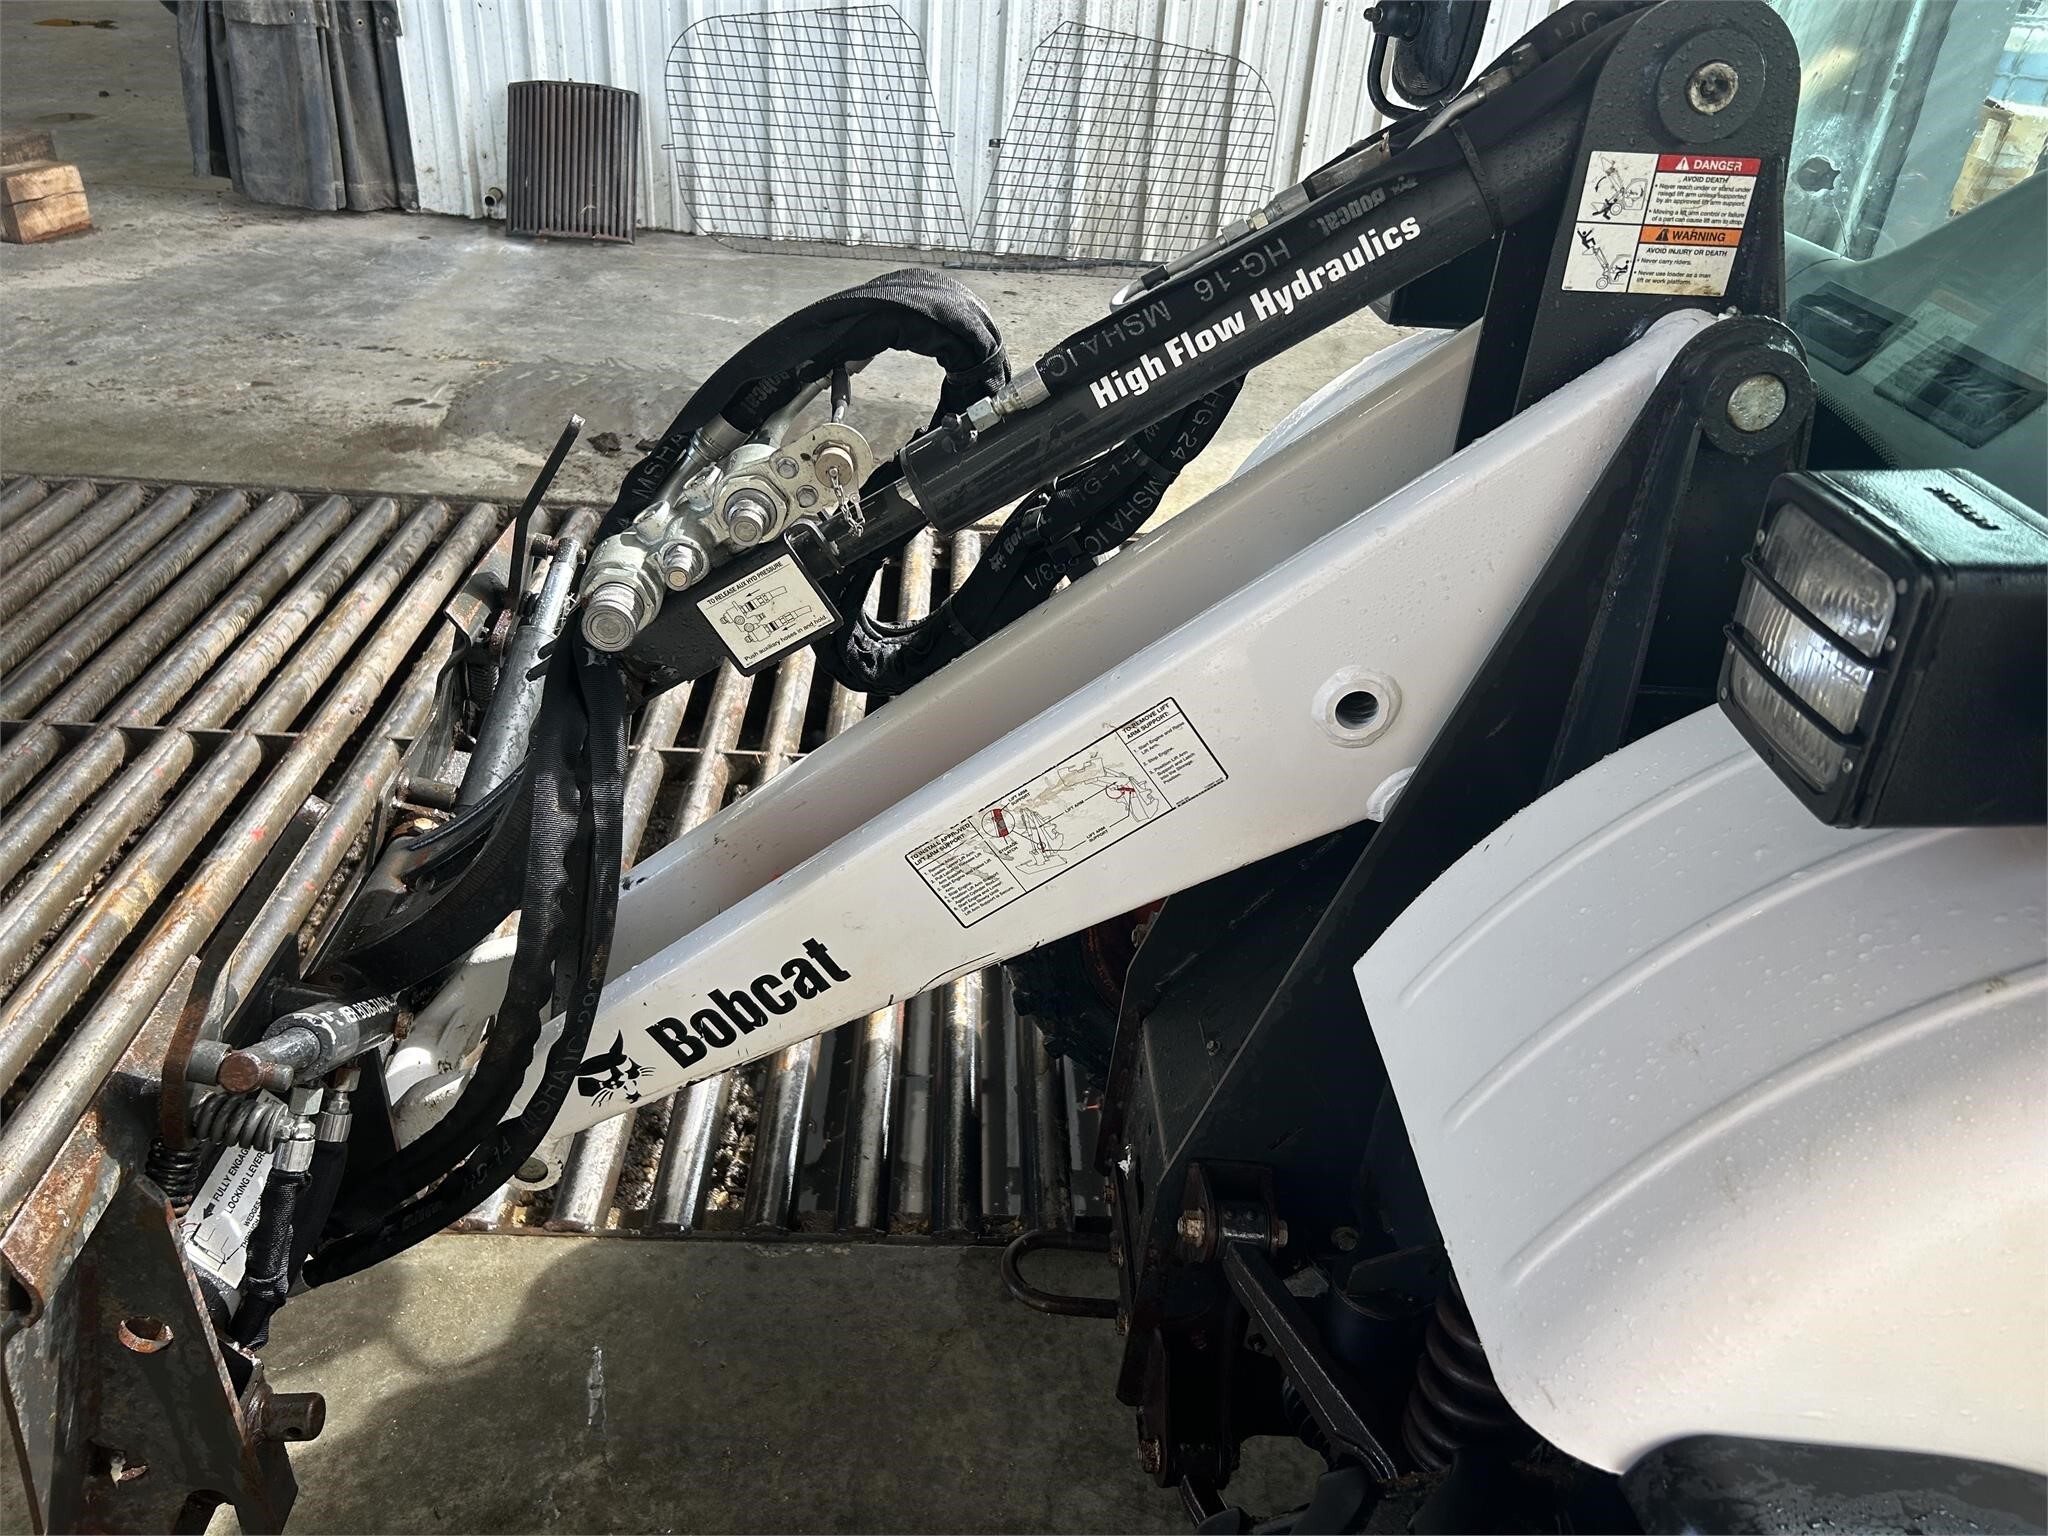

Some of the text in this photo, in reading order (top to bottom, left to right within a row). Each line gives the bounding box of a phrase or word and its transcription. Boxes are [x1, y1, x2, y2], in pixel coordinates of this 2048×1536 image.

[1694, 160, 1742, 171] DANGER
[1668, 248, 1692, 256] INJURY
[1673, 231, 1725, 242] WARNING
[1194, 237, 1292, 302] HG-16
[1089, 216, 1421, 409] High Flow Hydraulics
[1083, 300, 1172, 359] MSHA
[1106, 480, 1163, 533] MSHA
[707, 561, 782, 605] TO RELEASE AUX HYD PRESSURE
[744, 650, 758, 661] Push
[758, 639, 781, 654] auxiliary
[780, 630, 797, 642] hoses
[802, 621, 814, 630] and
[1122, 702, 1170, 733] TO REMOVE LIFT
[1126, 728, 1140, 738] ARM
[1138, 741, 1149, 749] Start
[1148, 733, 1164, 744] Engine
[1147, 755, 1159, 764] Stop
[1173, 758, 1183, 766] and
[1064, 799, 1084, 813] LIFT ARM
[917, 840, 941, 855] INSTALL
[940, 823, 970, 842] APPROVED
[914, 856, 927, 865] LIFT
[926, 848, 939, 858] ARM
[645, 938, 852, 1069] Bobcat
[213, 1148, 249, 1201] FULLY ENGAG
[225, 1177, 250, 1214] LOCKING
[243, 1200, 261, 1226] WEDGES
